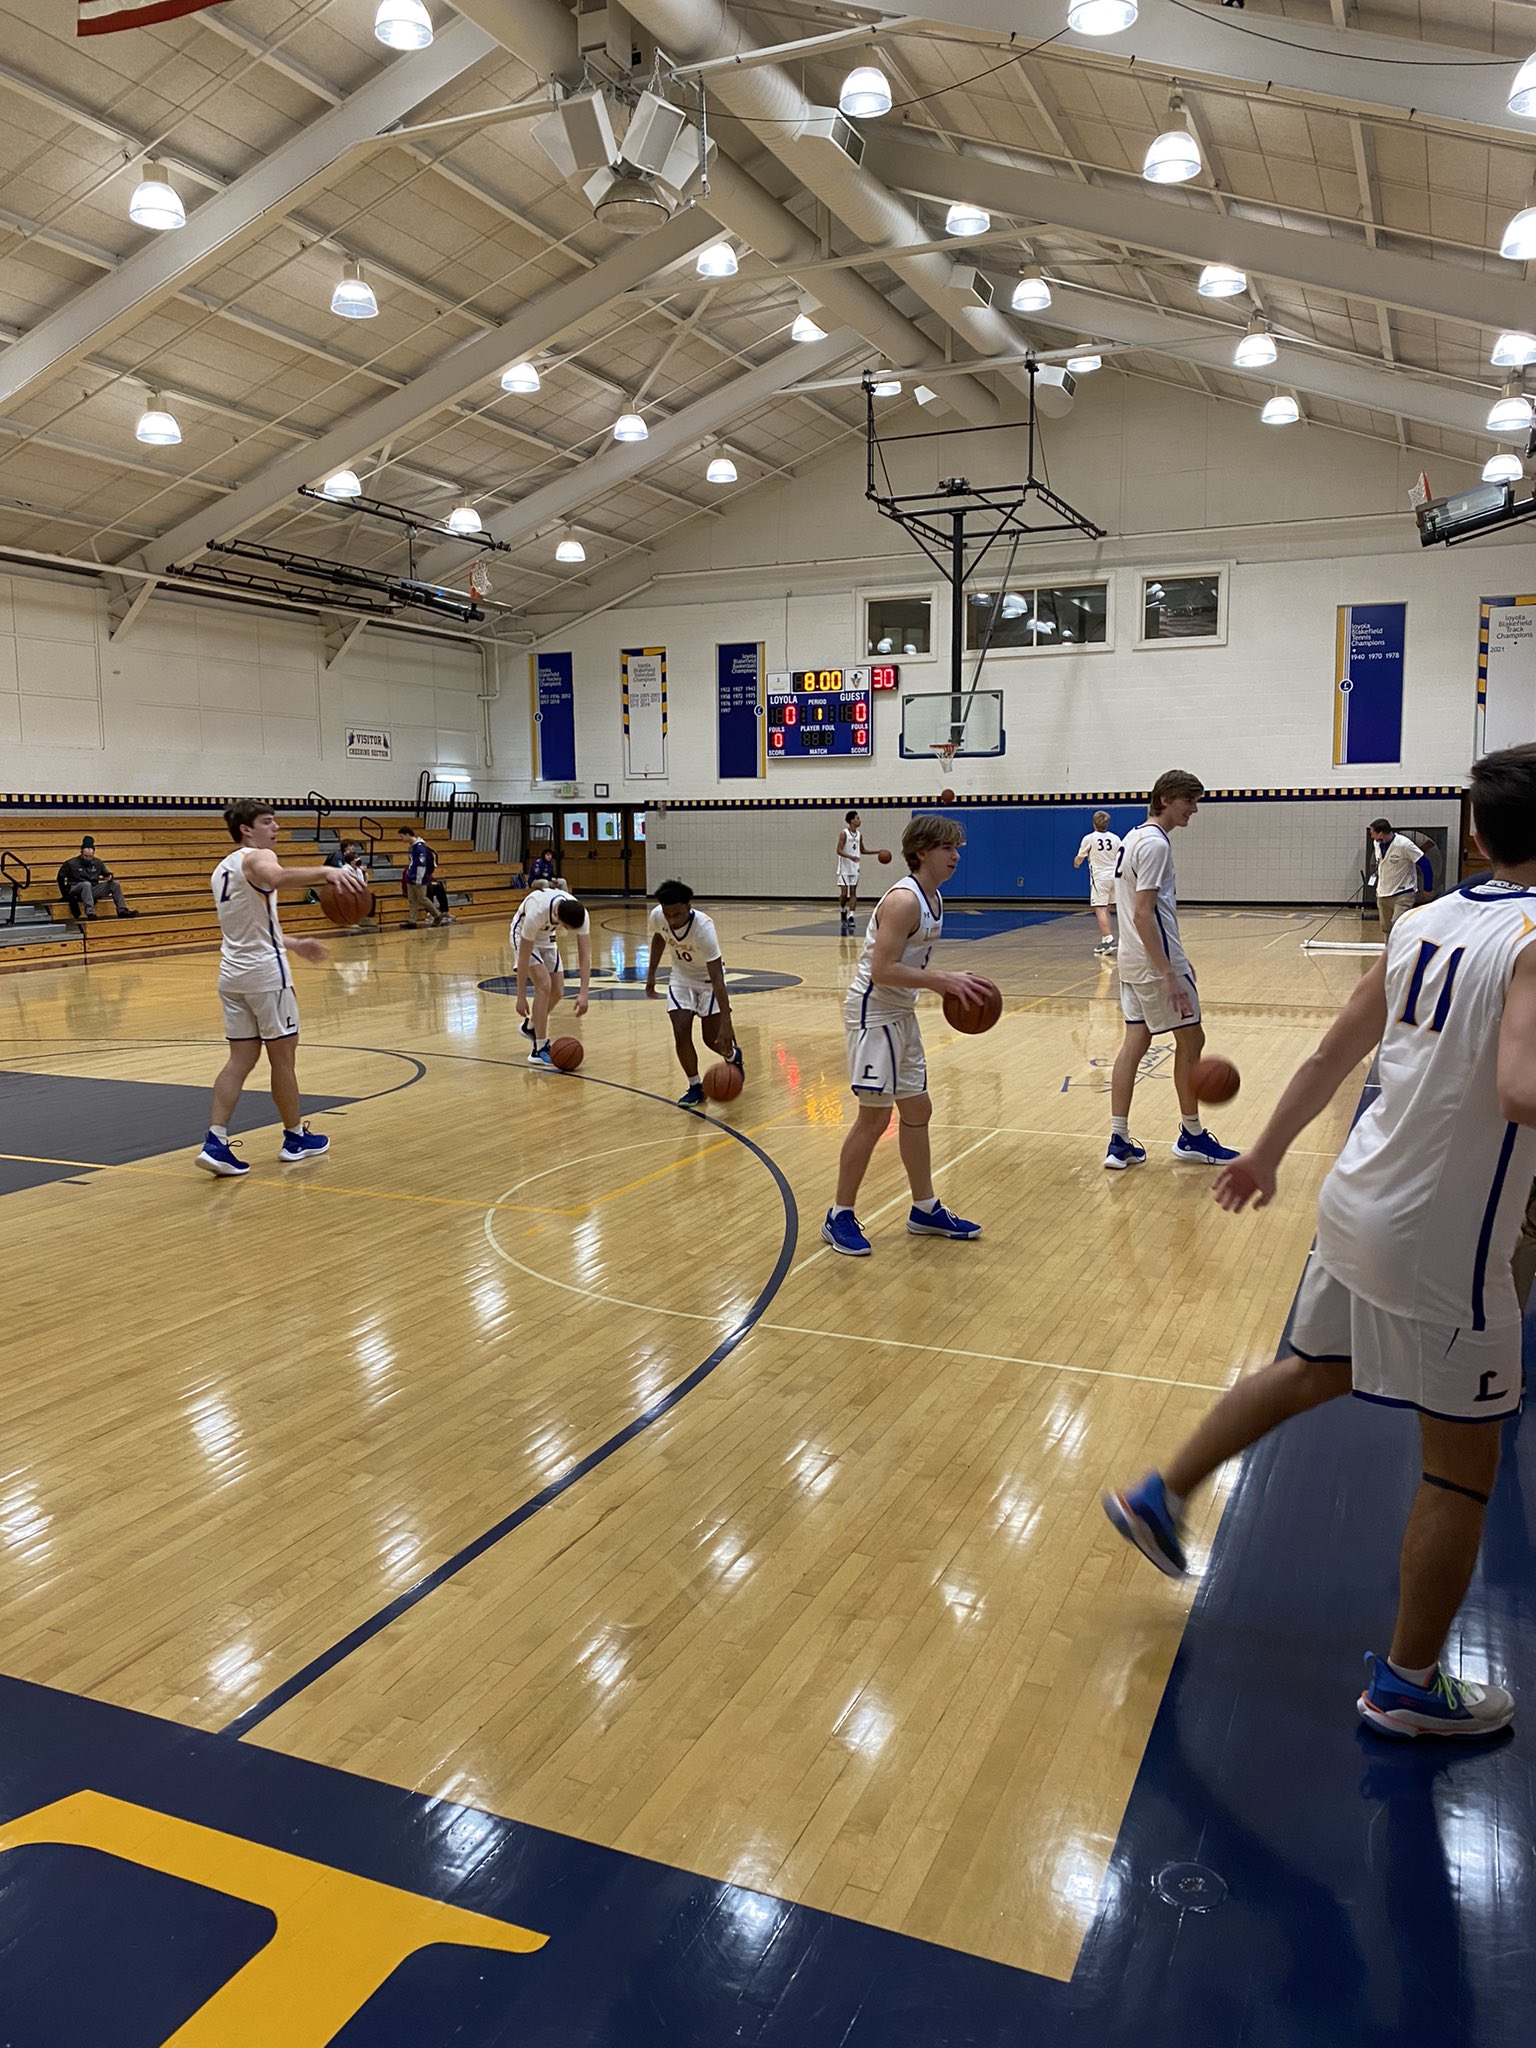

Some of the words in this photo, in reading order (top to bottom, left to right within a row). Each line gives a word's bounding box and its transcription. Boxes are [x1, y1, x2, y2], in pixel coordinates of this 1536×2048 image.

[1499, 620, 1532, 628] Blakefield
[1496, 632, 1533, 640] Champions
[1368, 652, 1383, 660] 1970
[873, 668, 895, 689] 30
[770, 695, 798, 705] LOYOLA
[840, 692, 865, 702] GUEST
[785, 706, 796, 725] 0
[855, 702, 867, 722] 0
[356, 734, 382, 745] VISITOR
[774, 733, 783, 748] 0
[857, 730, 866, 745] 0
[1097, 838, 1112, 851] 33
[675, 949, 692, 962] 10
[1398, 937, 1467, 1033] 11
